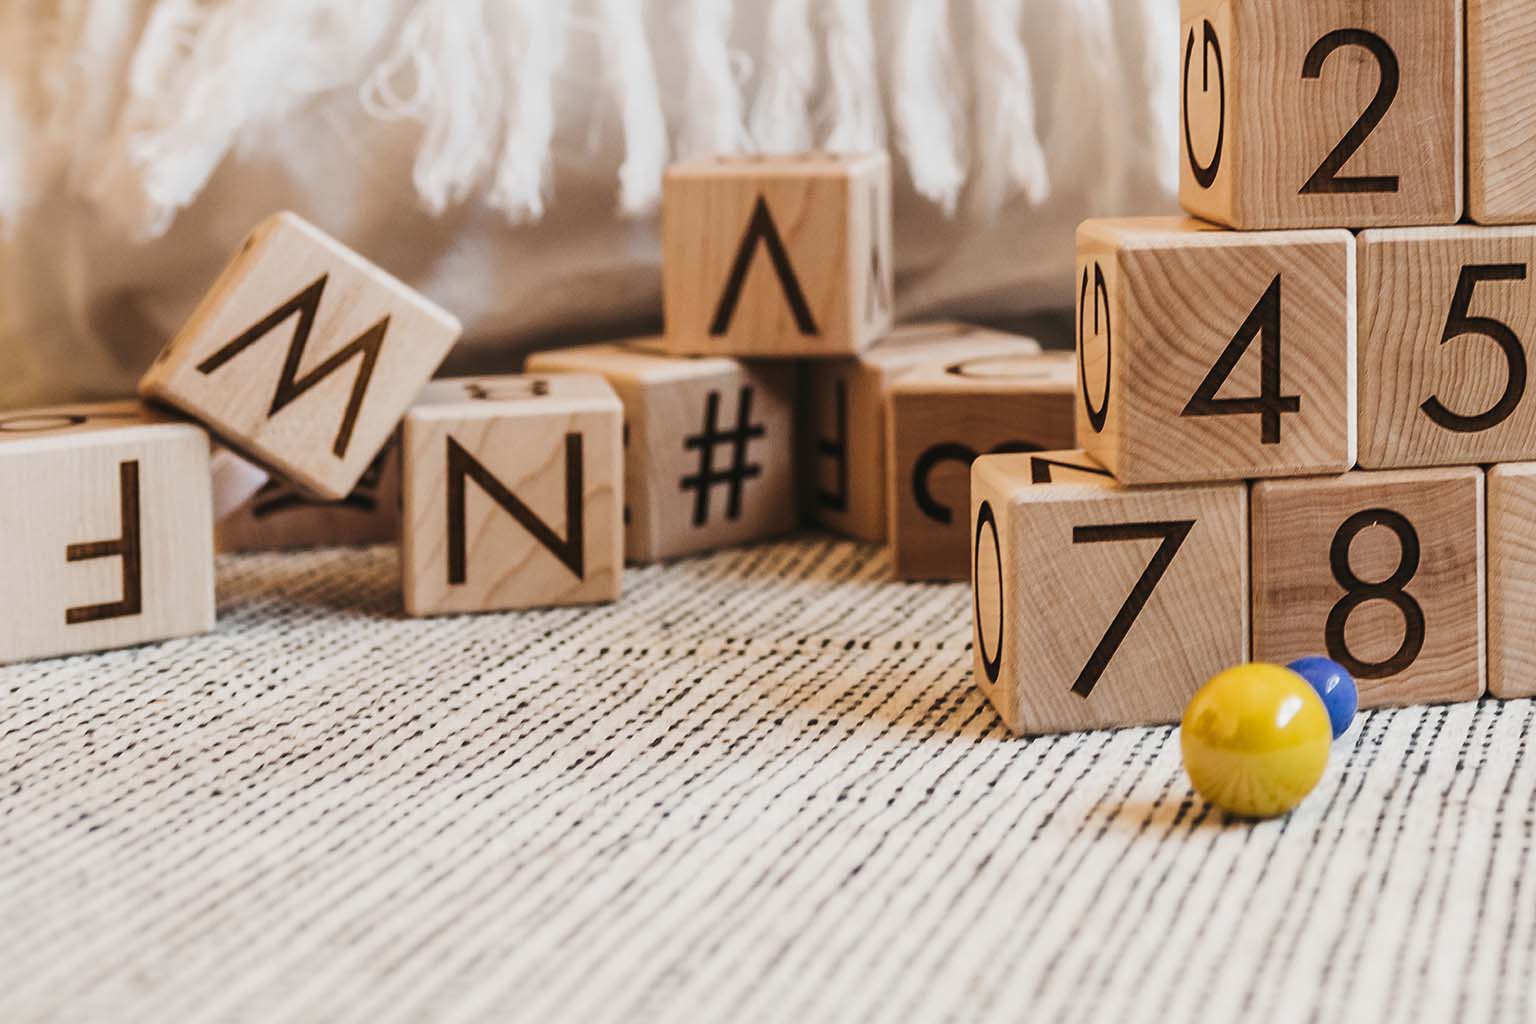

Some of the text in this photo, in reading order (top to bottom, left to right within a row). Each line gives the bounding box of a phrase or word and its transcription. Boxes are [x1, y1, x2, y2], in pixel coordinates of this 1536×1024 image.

[1184, 19, 1224, 189] G
[1298, 28, 1399, 194] 2
[1080, 261, 1111, 433] G
[1180, 273, 1300, 444] 4
[1420, 263, 1527, 432] 5
[447, 433, 584, 585] N
[680, 386, 766, 528] #
[1071, 520, 1196, 698] 7
[1325, 508, 1425, 679] 8
